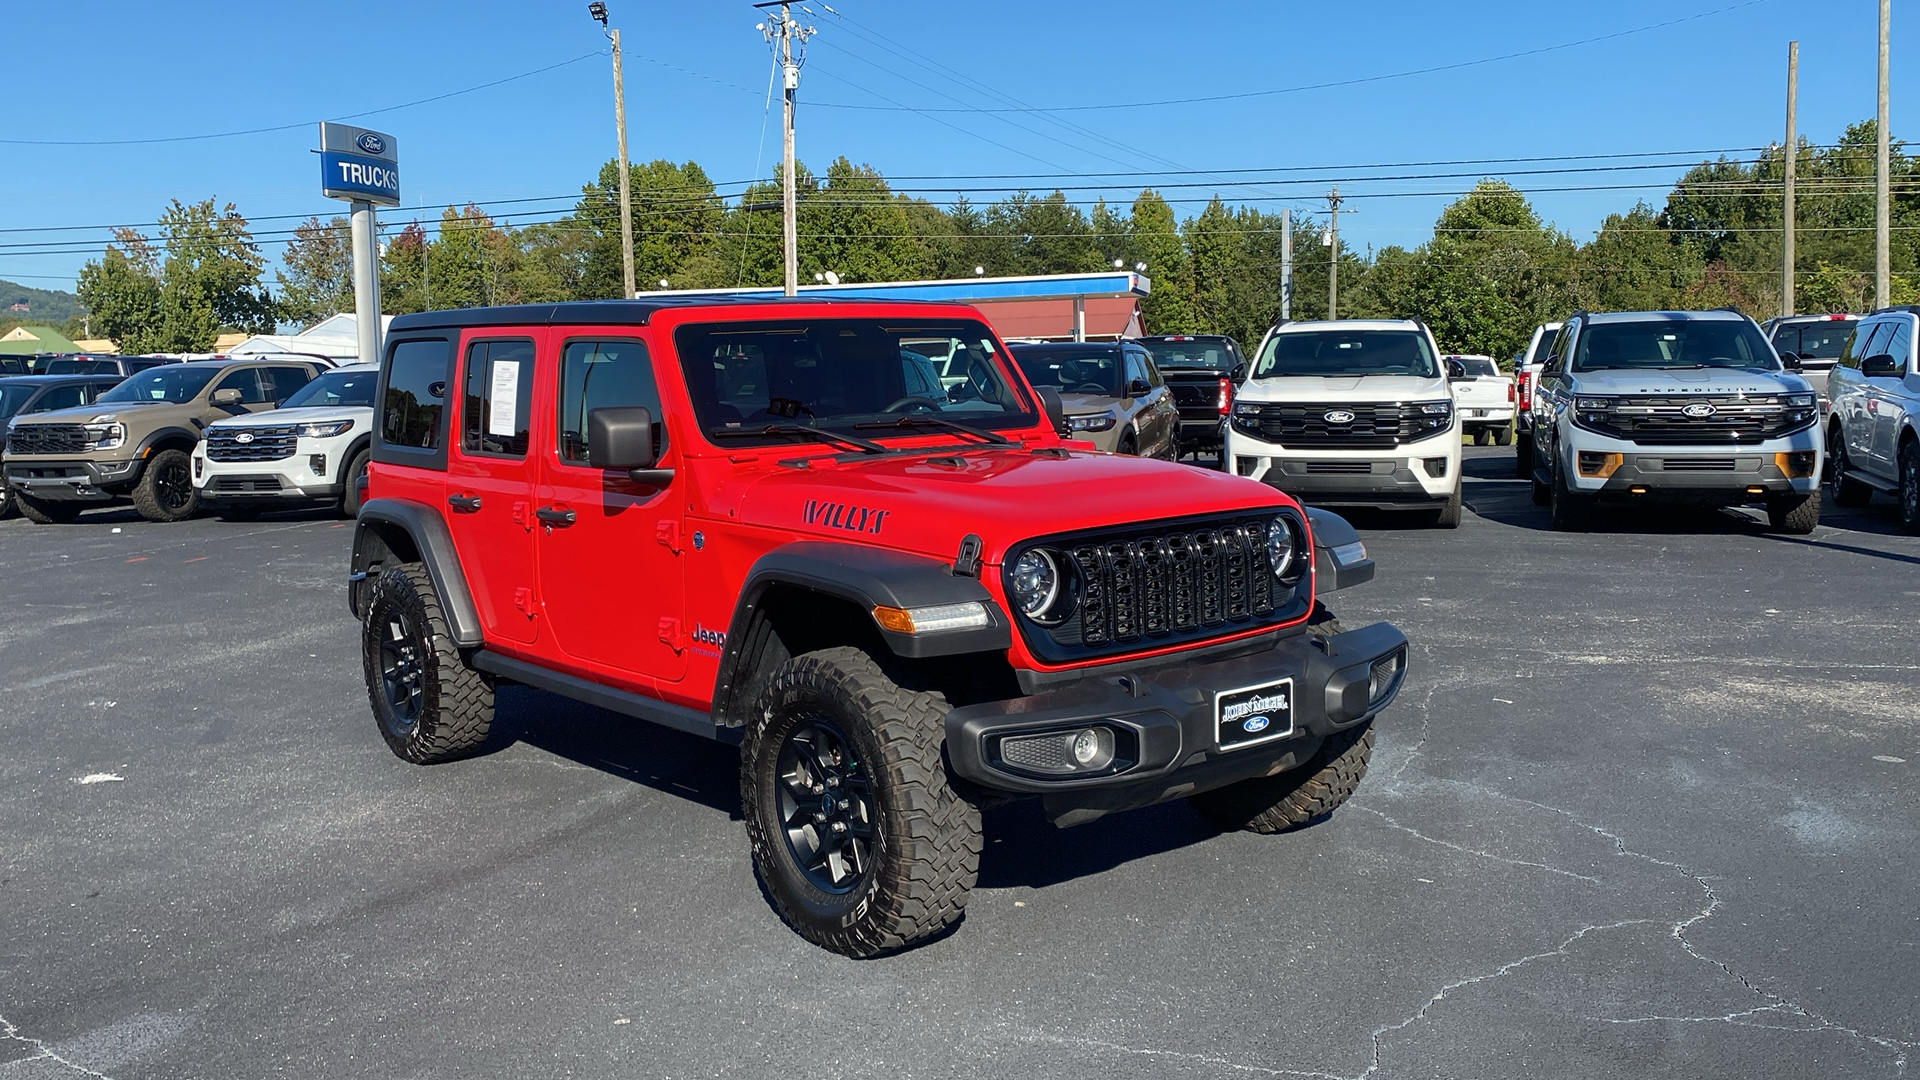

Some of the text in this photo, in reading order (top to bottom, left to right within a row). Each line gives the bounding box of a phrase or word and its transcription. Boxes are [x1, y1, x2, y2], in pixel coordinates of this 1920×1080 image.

[364, 135, 382, 150] Ford
[338, 161, 398, 190] TRUCKS
[803, 500, 891, 534] WILLYS
[691, 622, 727, 651] Jeep
[1223, 702, 1253, 721] JOHN
[1248, 718, 1266, 731] Ford
